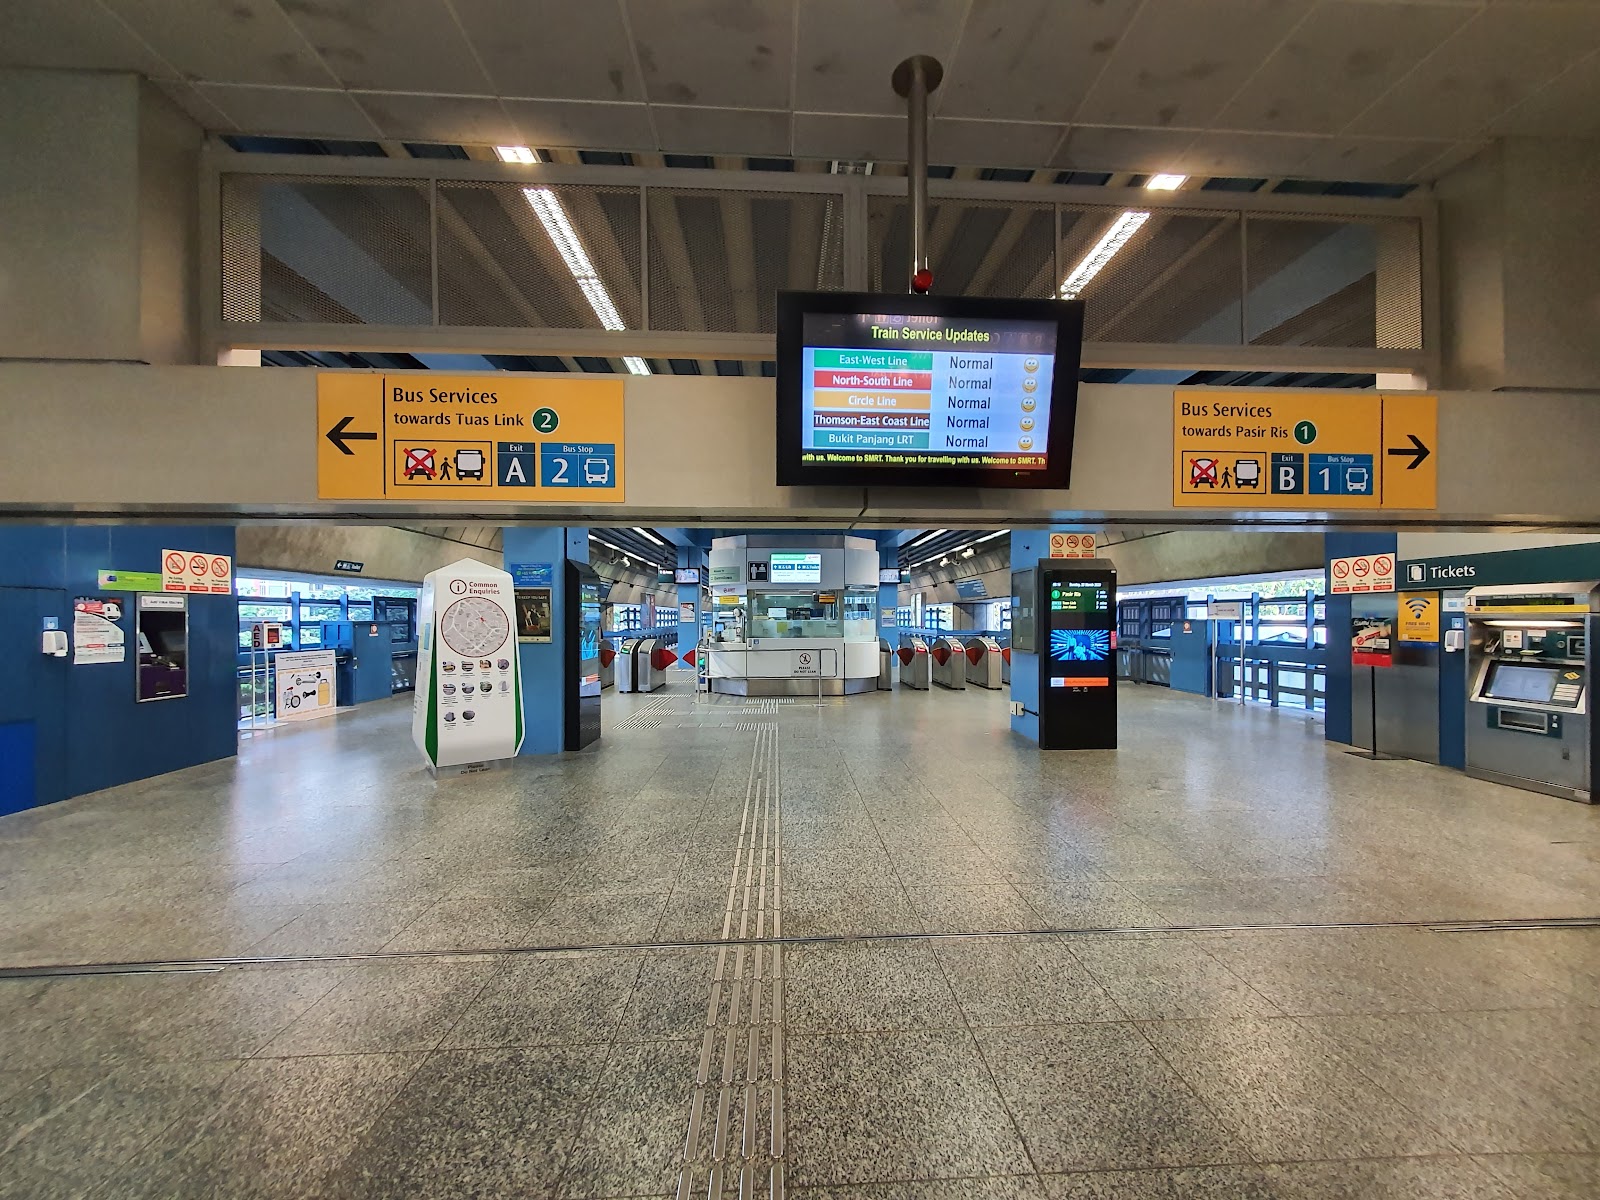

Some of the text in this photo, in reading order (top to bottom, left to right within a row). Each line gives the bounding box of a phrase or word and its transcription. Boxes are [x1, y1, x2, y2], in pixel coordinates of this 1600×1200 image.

[871, 325, 990, 344] Train Service Updates
[839, 354, 908, 366] East-West Line
[950, 356, 993, 370] Normal
[832, 375, 913, 387] North-South Line
[949, 376, 992, 390] Normal
[393, 387, 498, 404] Bus Services
[848, 395, 897, 406] Circle Line
[948, 396, 991, 410] Normal
[1181, 402, 1272, 418] Bus Services
[394, 412, 552, 429] towards Tuas Link 2
[814, 414, 930, 427] Thomson-East Coast Line
[947, 415, 990, 429] Normal
[828, 433, 914, 446] Bukit Panjang LRT
[1182, 425, 1309, 440] towards Pasir Ris 1
[509, 444, 523, 452] Exit
[946, 434, 988, 448] Normal
[562, 445, 594, 455] Bus Stop
[827, 453, 856, 462] Welcome
[856, 454, 864, 462] to
[864, 454, 884, 463] SMRT.
[884, 454, 904, 463] Thank
[904, 456, 917, 465] you
[917, 455, 927, 464] for
[927, 455, 956, 465] travelling
[957, 456, 970, 464] with
[981, 456, 1009, 465] Welcome
[1010, 457, 1016, 465] to
[1017, 456, 1036, 466] SMRT.
[1327, 455, 1355, 465] Bus Stop
[505, 457, 527, 483] A
[551, 458, 569, 484] 2
[1279, 466, 1296, 491] B
[1318, 468, 1330, 491] 1
[1430, 565, 1476, 578] Tickets
[1467, 596, 1474, 606] 1
